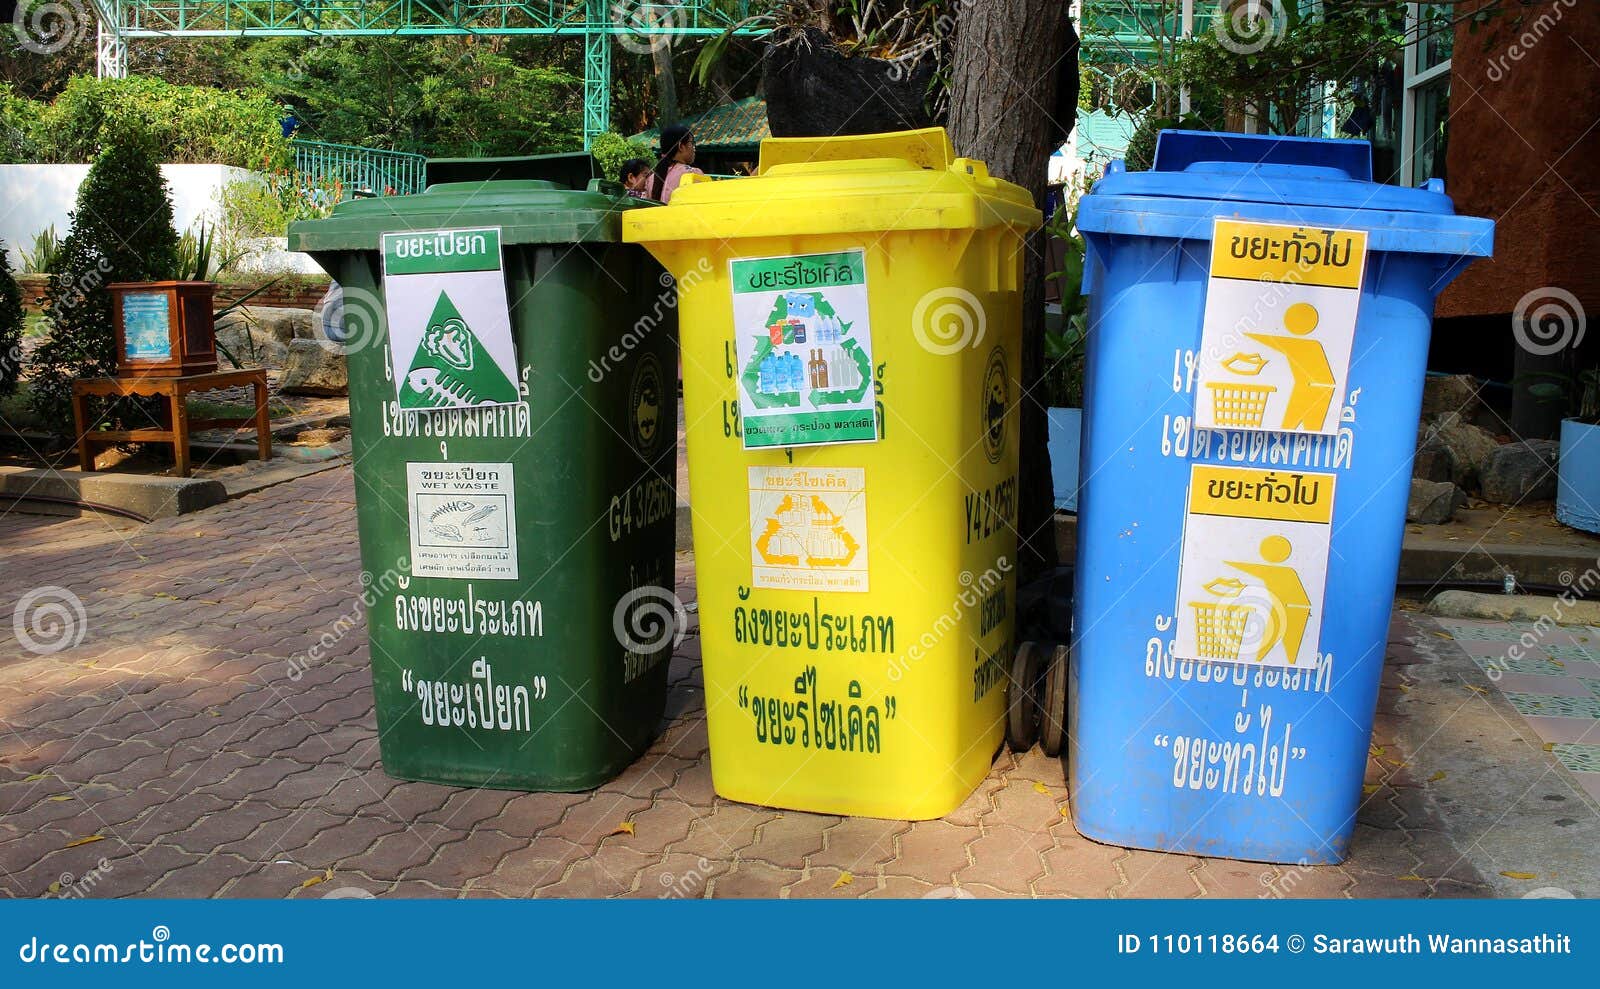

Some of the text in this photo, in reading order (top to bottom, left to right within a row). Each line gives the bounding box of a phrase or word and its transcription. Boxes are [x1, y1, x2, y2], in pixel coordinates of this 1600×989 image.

[1231, 227, 1352, 267] ขยะทั่วไป
[750, 262, 853, 288] ขยะรีไซเคิล
[421, 467, 499, 480] ขยะเปียก
[765, 471, 847, 488] ขยะรีไซเคิล
[1208, 472, 1319, 505] ขยะทั่วไป
[395, 575, 543, 637] ถังขยะประเภท
[734, 585, 895, 654] ถังขยะประเภท
